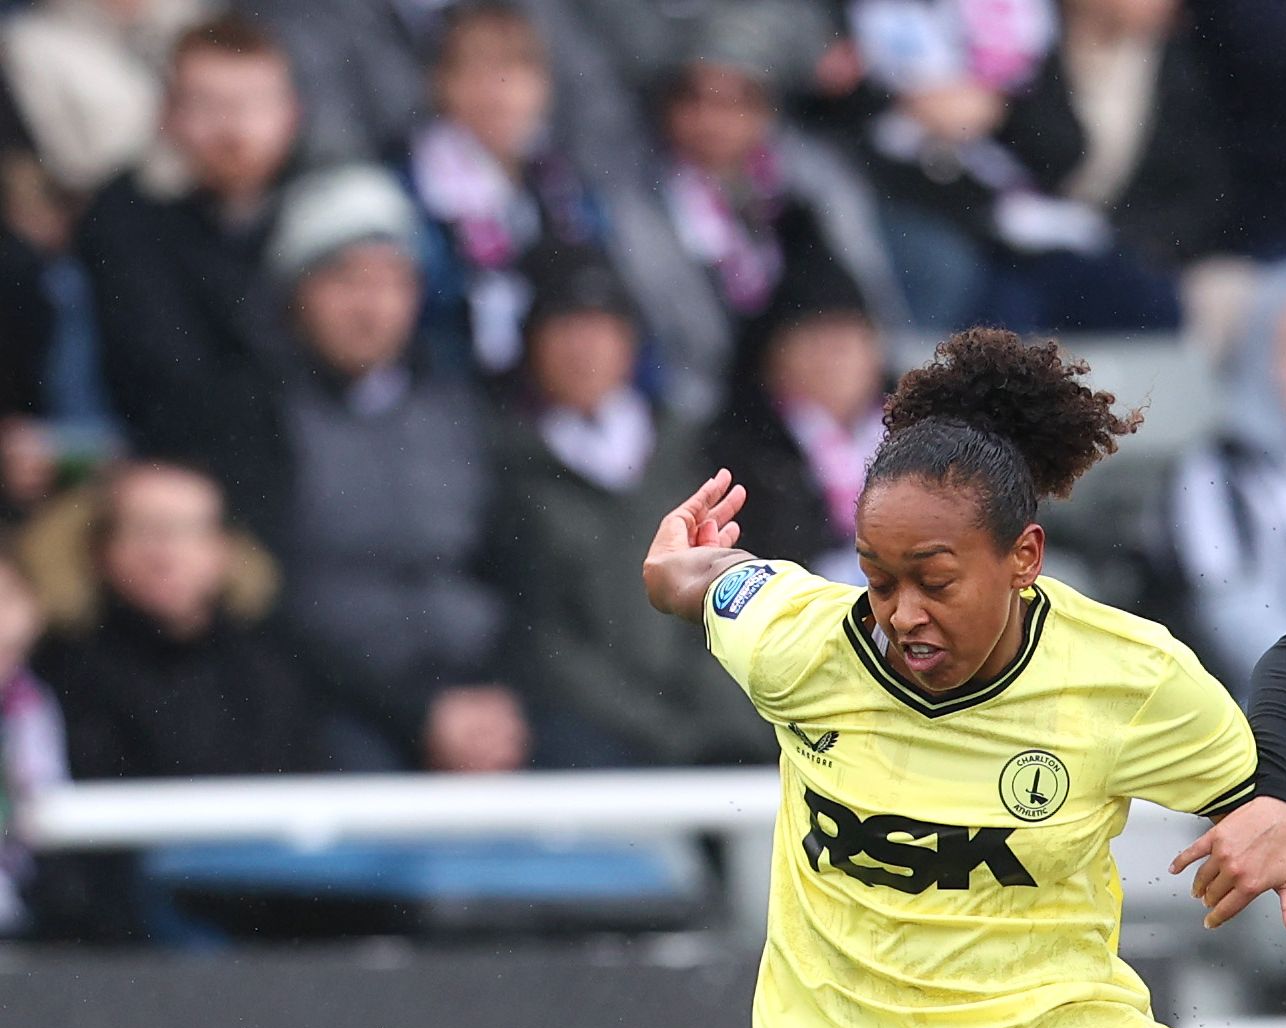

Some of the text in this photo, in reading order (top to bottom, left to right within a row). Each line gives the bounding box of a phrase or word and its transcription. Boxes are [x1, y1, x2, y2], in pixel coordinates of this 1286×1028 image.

[796, 745, 833, 769] CASTORE
[1016, 755, 1061, 773] CHARLTON
[1013, 804, 1049, 817] ATHLETIC
[802, 786, 1039, 895] RSK
